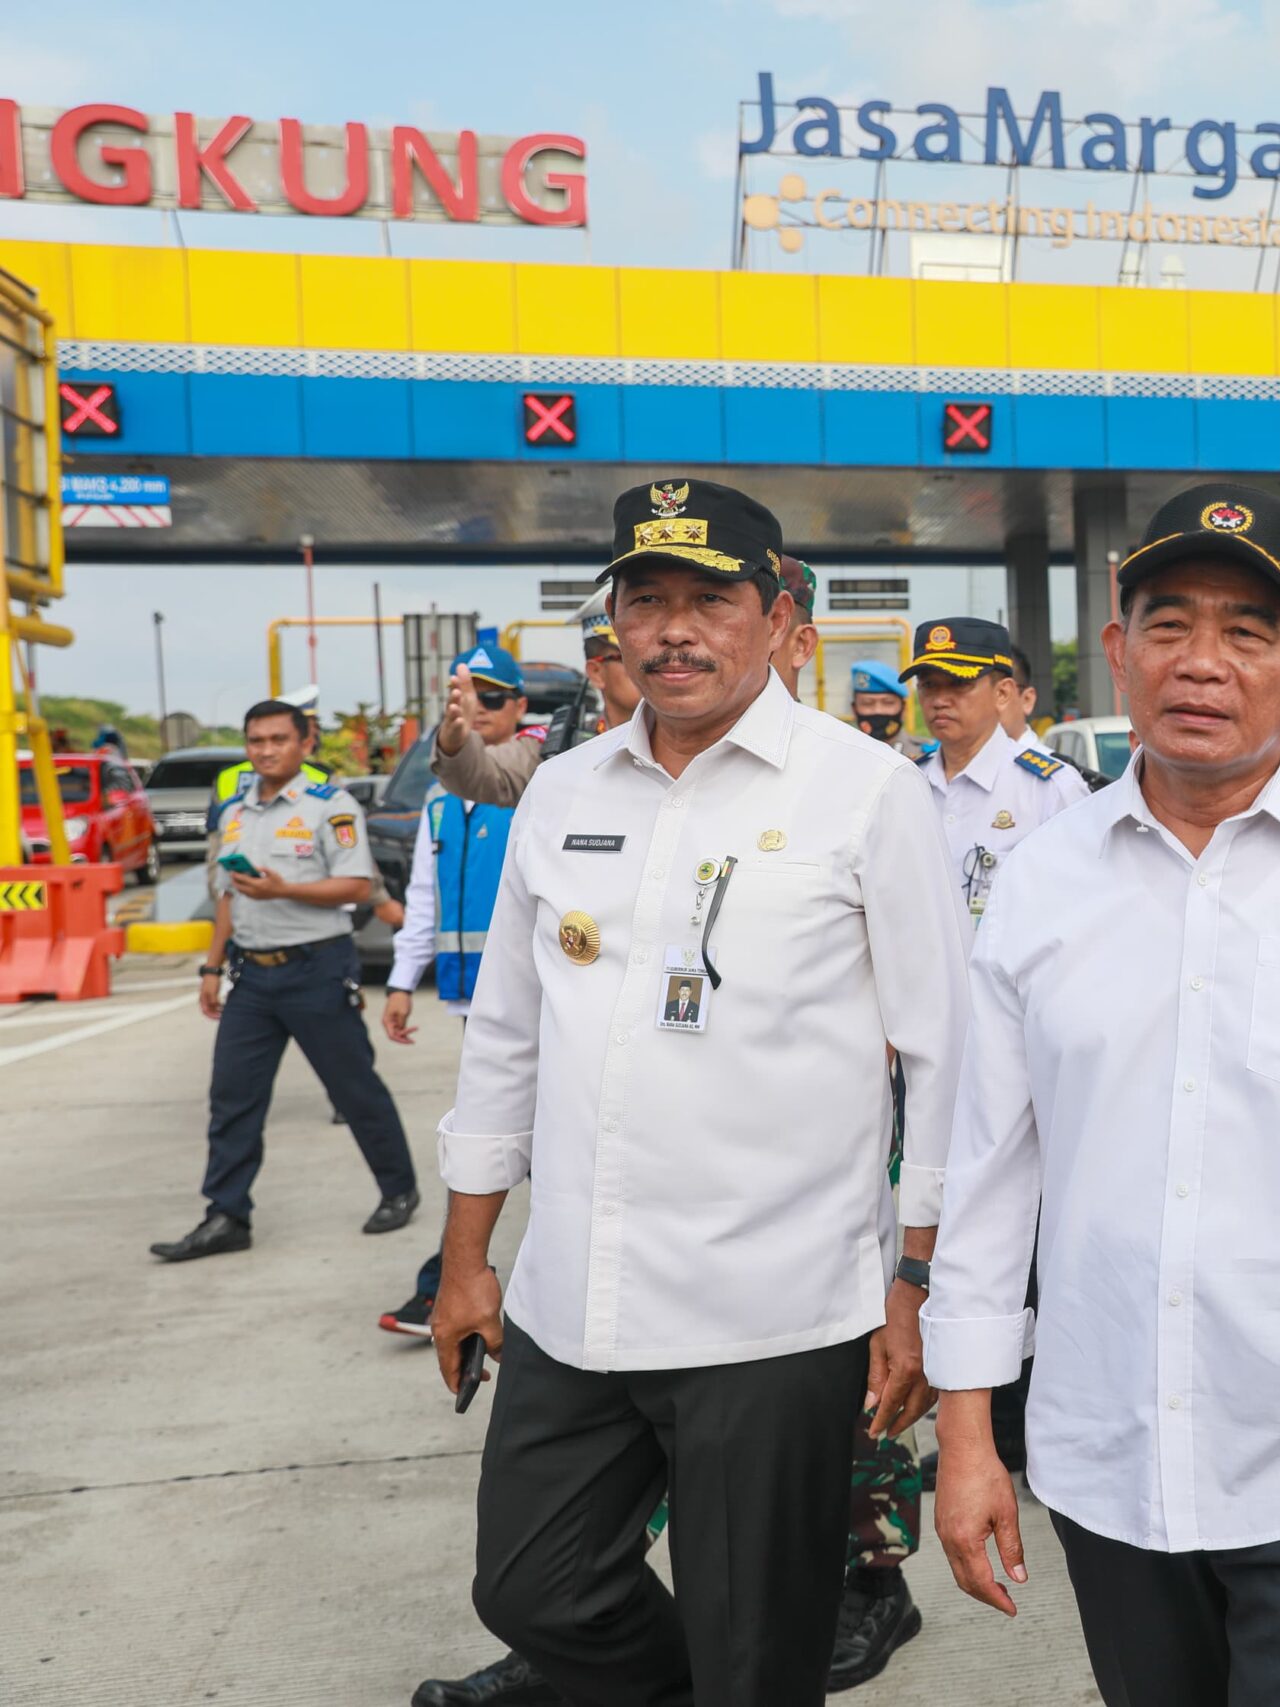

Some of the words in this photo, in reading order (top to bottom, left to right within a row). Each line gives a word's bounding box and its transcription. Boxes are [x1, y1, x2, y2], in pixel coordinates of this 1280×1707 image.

[813, 187, 1076, 249] Connecting
[571, 838, 587, 846] NANA
[588, 838, 616, 847] SUDJANA
